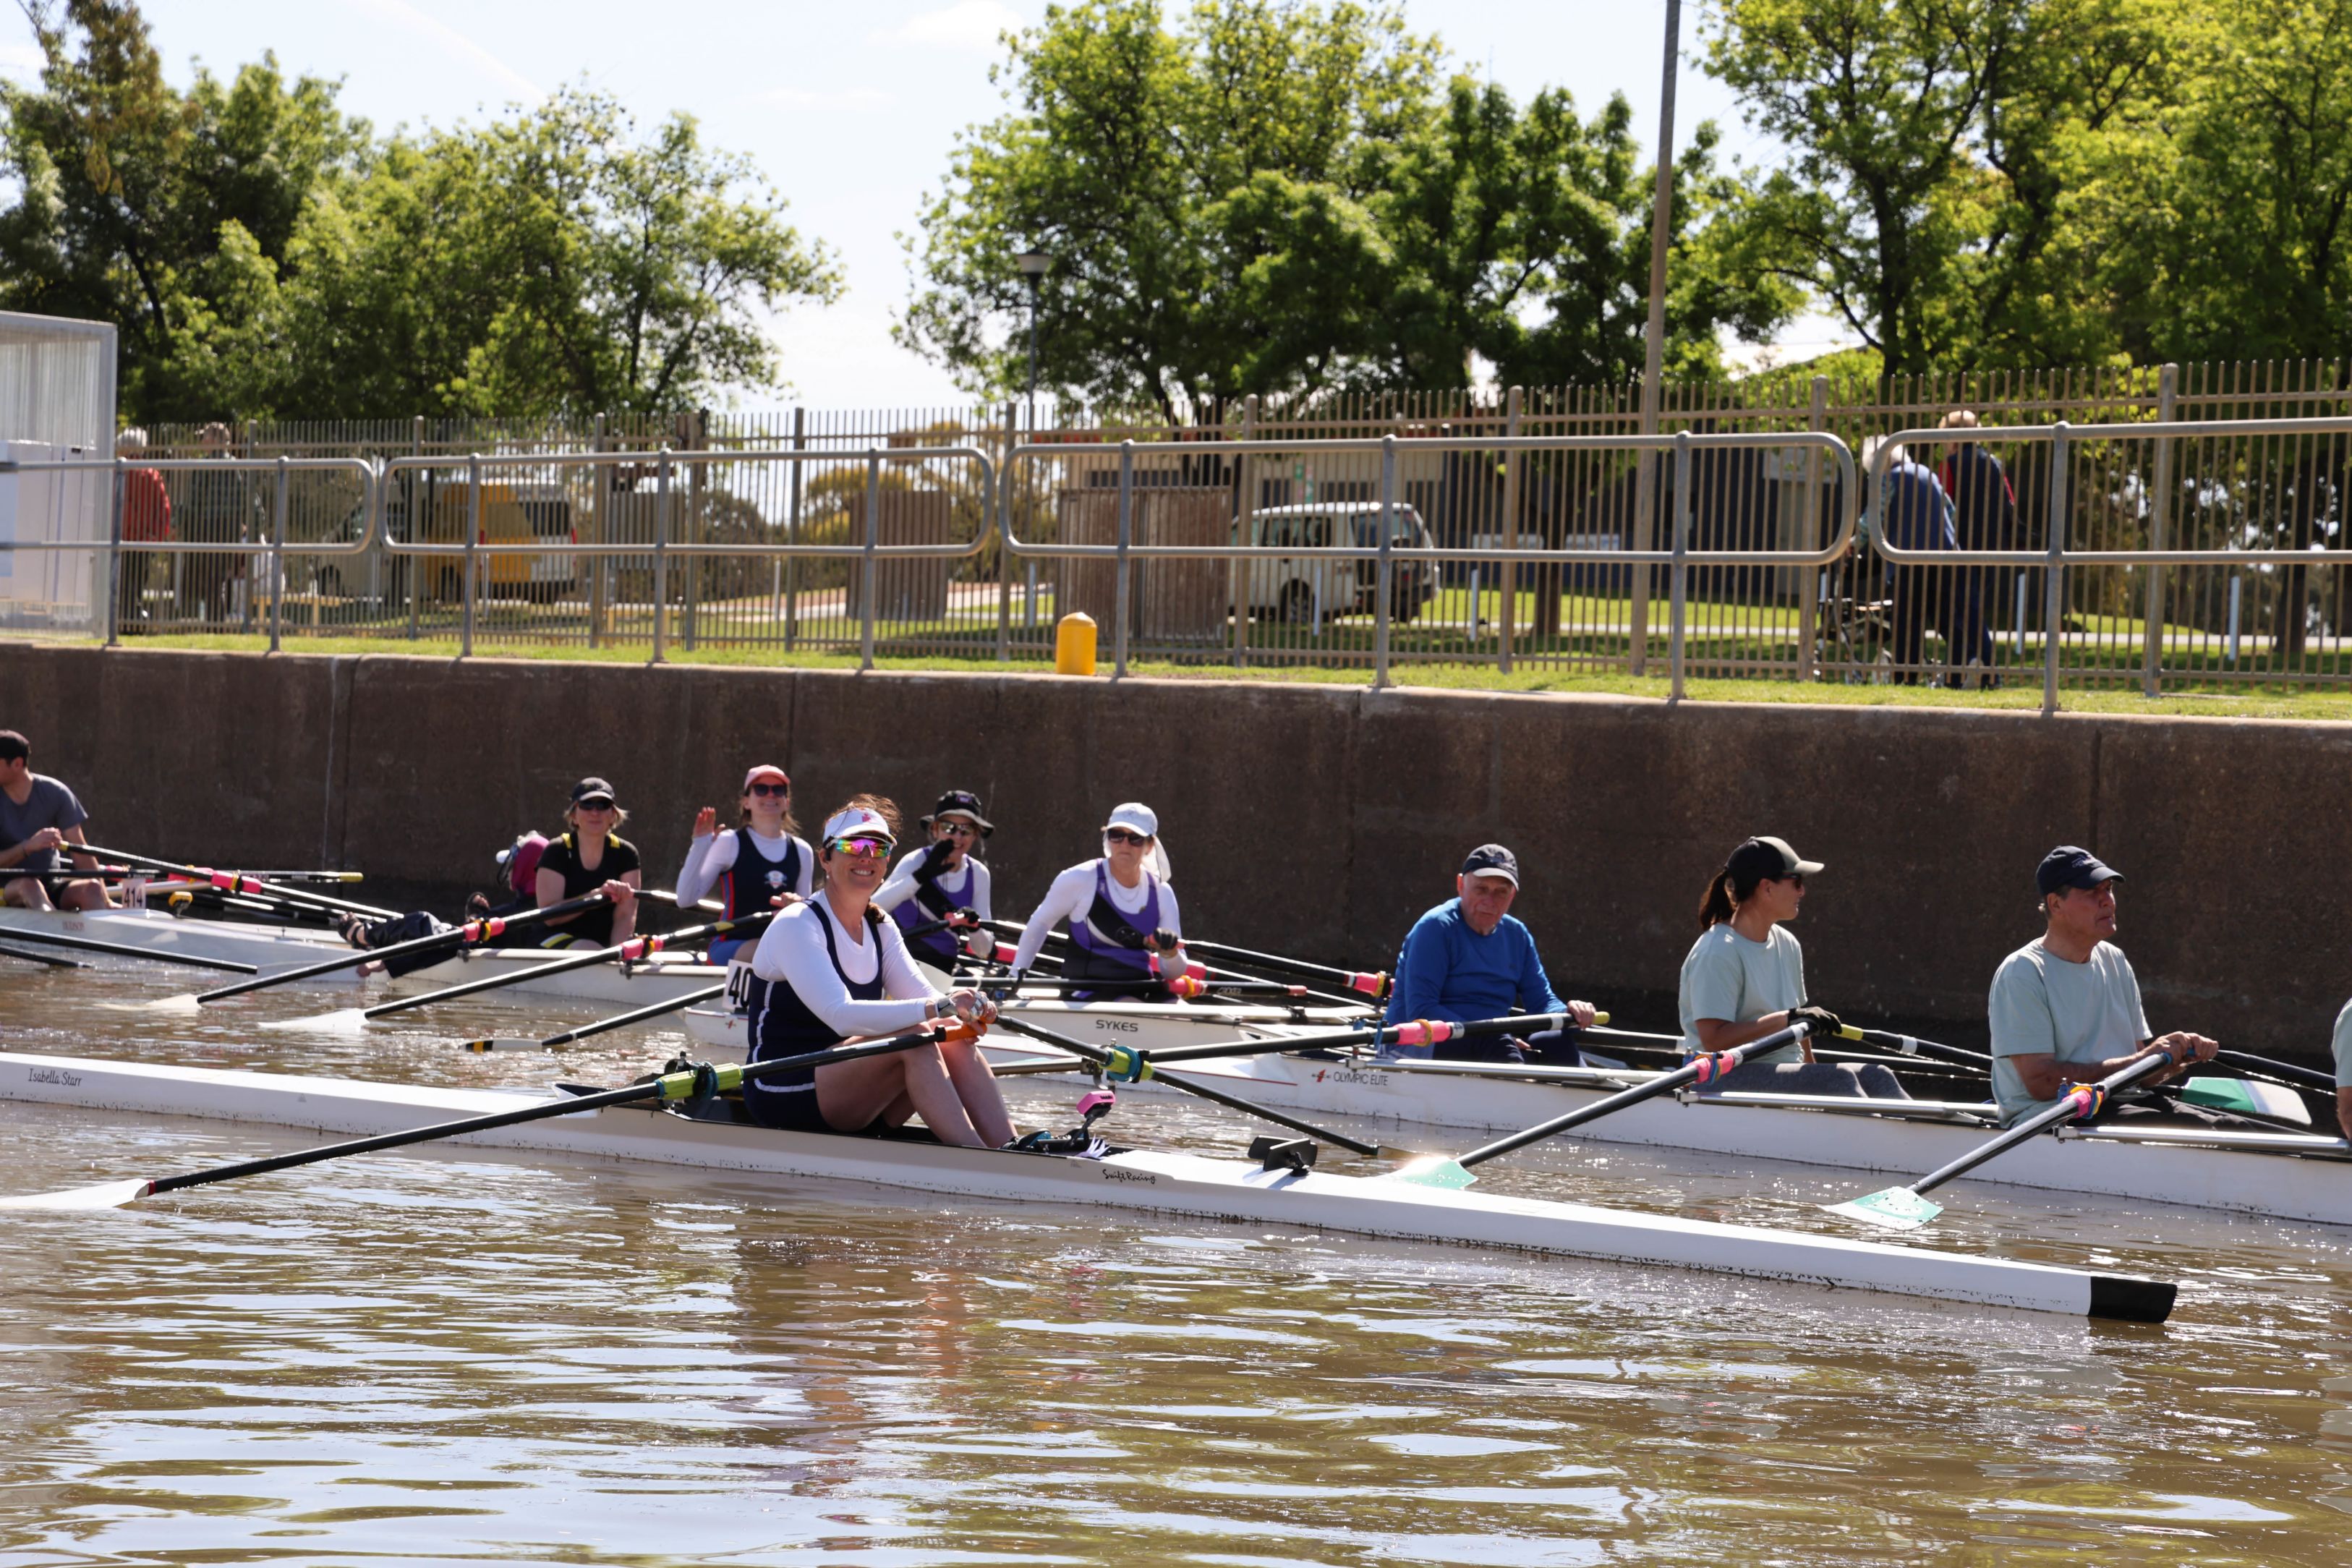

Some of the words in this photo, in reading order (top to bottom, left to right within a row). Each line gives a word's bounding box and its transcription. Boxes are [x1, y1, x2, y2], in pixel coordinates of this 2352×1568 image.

[124, 887, 143, 908] 414
[1096, 1019, 1138, 1033] SYKES
[28, 1068, 60, 1085] Isabella
[61, 1071, 82, 1087] Starr
[1334, 1071, 1368, 1085] OLYMPIC
[1370, 1075, 1389, 1086] ELITE
[1102, 1168, 1126, 1183] Swift
[1126, 1171, 1156, 1185] Racing
